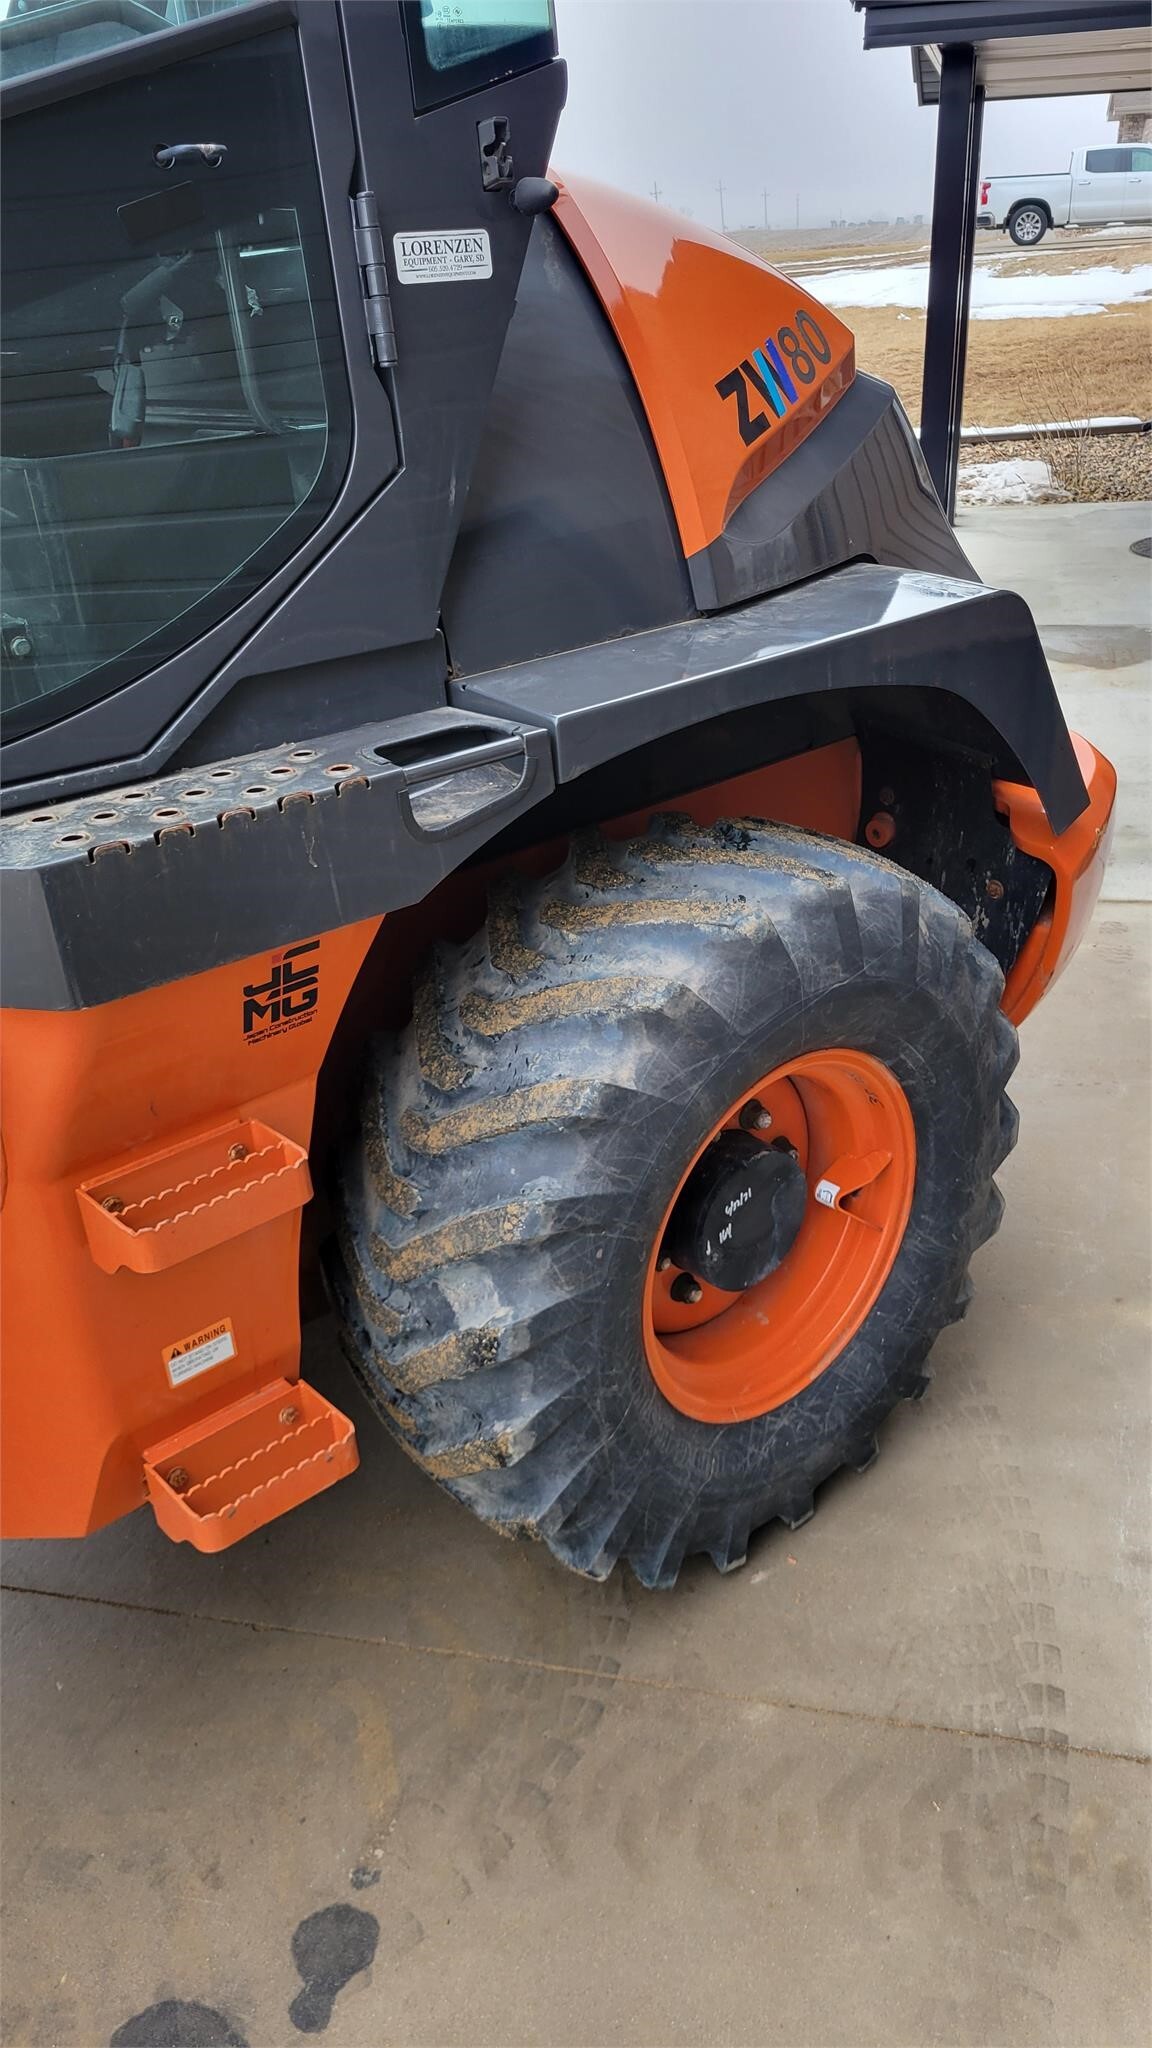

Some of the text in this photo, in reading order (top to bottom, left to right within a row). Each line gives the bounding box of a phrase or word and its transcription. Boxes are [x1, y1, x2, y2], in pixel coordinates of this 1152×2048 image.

[400, 238, 484, 257] LORENZEN
[403, 256, 447, 268] EQUIPMENT
[454, 254, 475, 264] GARY,
[476, 254, 485, 262] SD
[714, 309, 831, 447] ZW80
[243, 1009, 318, 1041] Japan Construction
[248, 1016, 313, 1046] Machinery Global
[183, 1324, 226, 1352] WARNING
